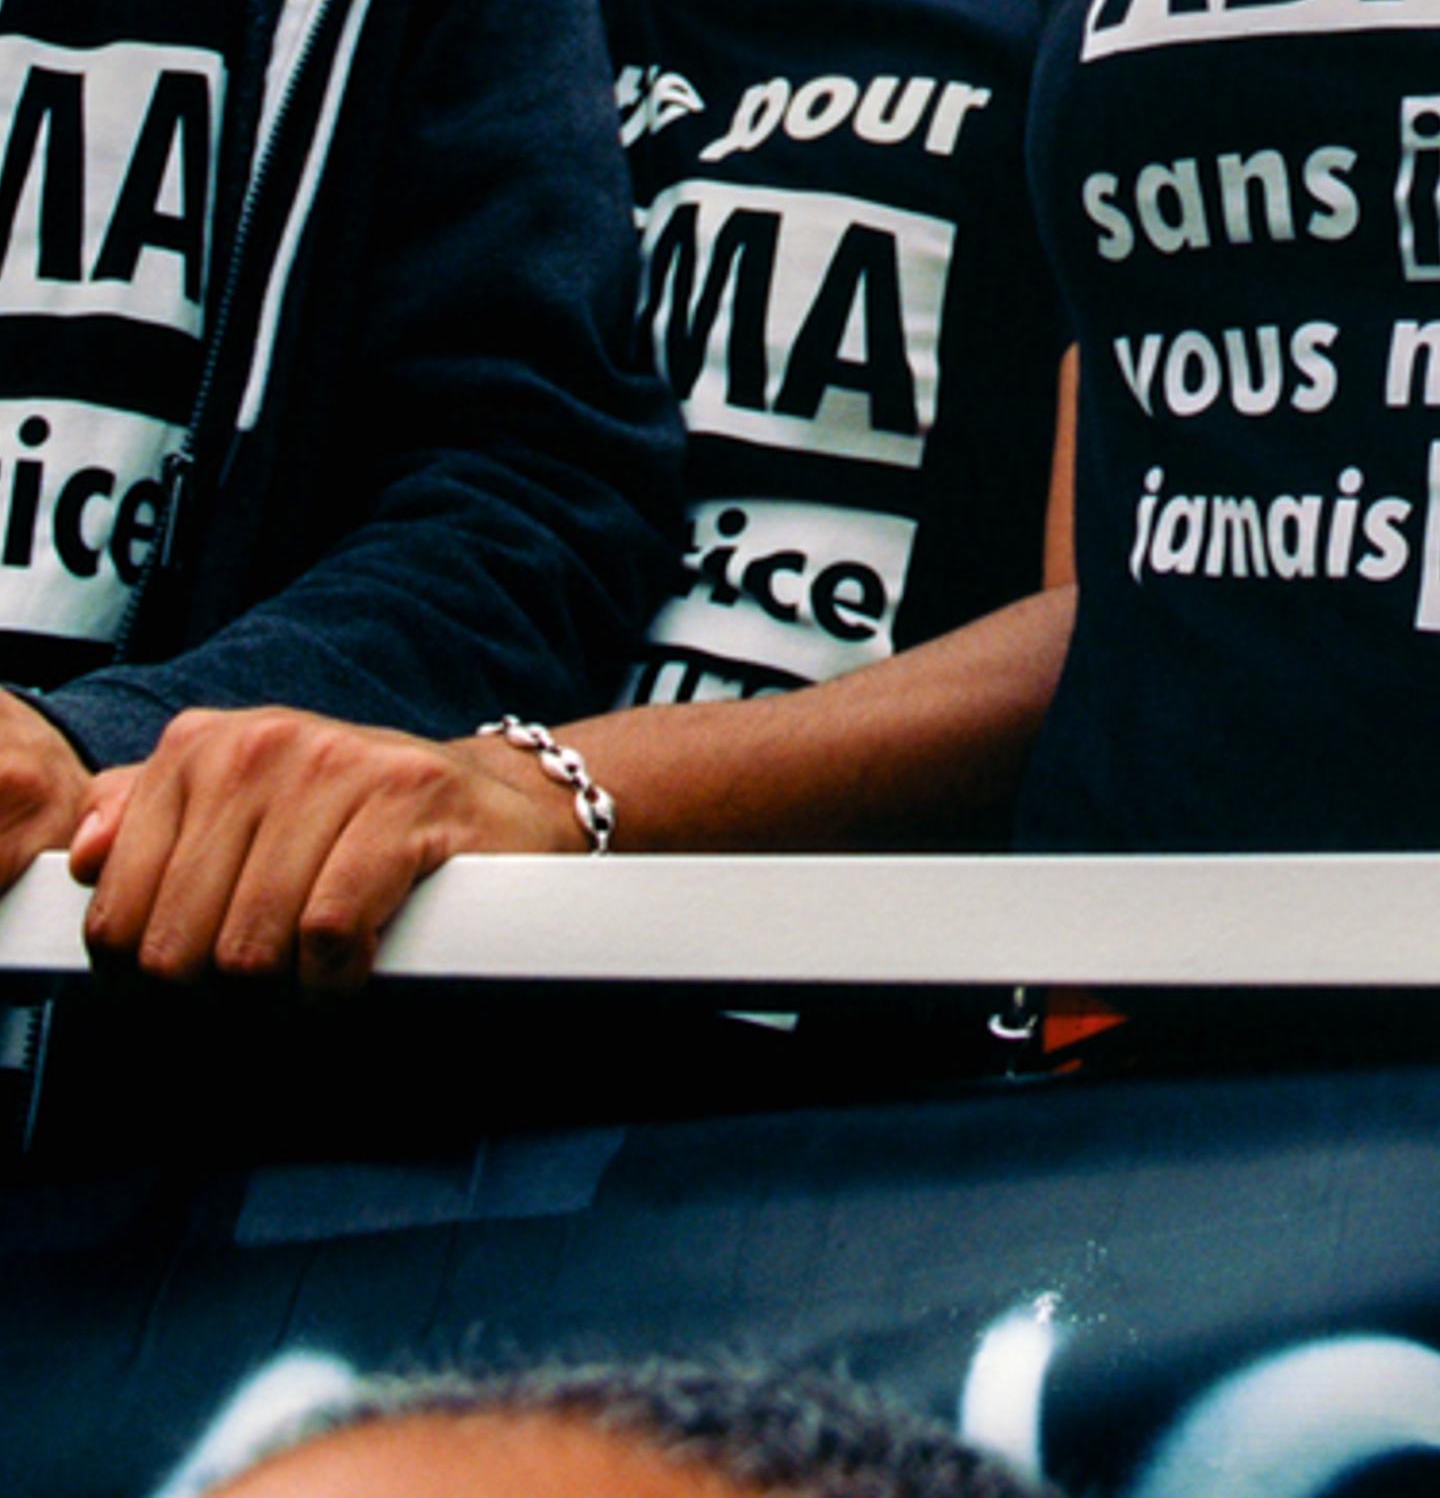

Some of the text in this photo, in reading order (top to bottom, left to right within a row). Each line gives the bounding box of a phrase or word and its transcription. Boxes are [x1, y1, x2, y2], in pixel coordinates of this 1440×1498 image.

[698, 74, 991, 162] pour
[1082, 145, 1359, 262] sans
[1114, 320, 1340, 418] vous
[1130, 467, 1413, 585] jamais
